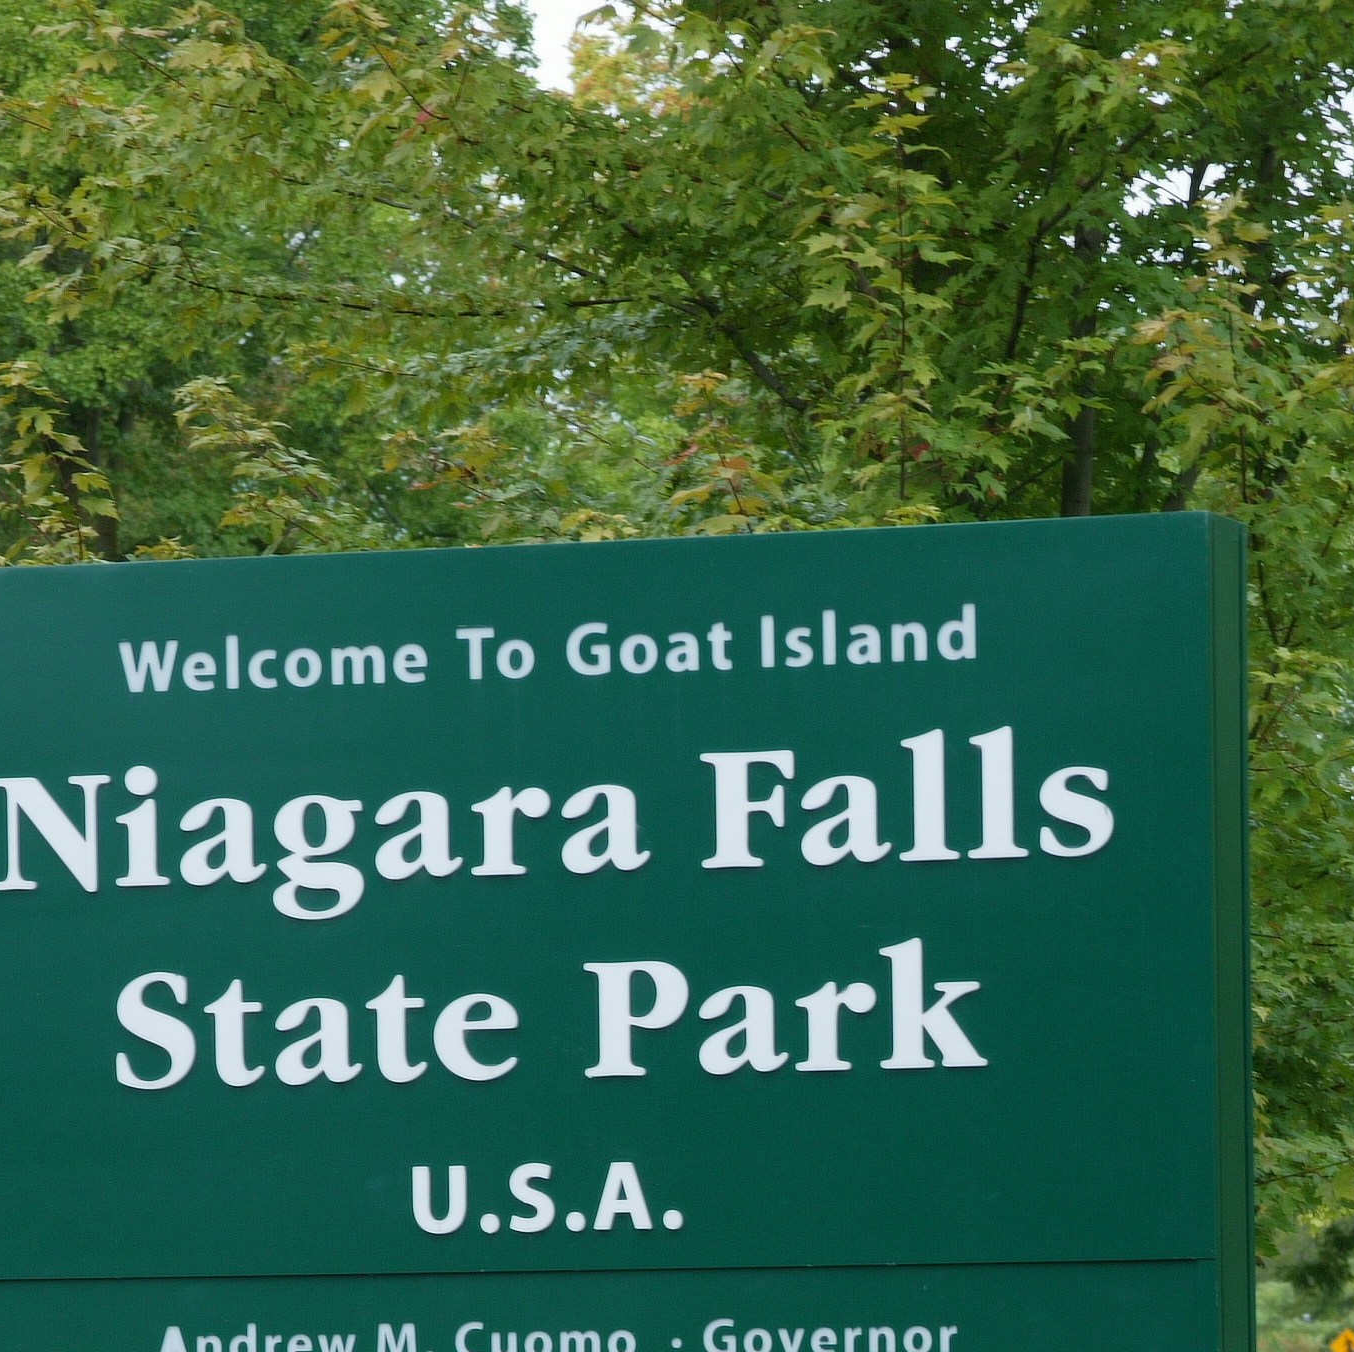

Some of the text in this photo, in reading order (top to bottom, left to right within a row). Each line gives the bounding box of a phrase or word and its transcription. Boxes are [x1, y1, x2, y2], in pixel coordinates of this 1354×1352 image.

[118, 603, 978, 693] Welcome To Goat Island
[699, 725, 1115, 869] Falls
[115, 937, 989, 1090] State Park
[411, 1161, 684, 1235] U.S.A.
